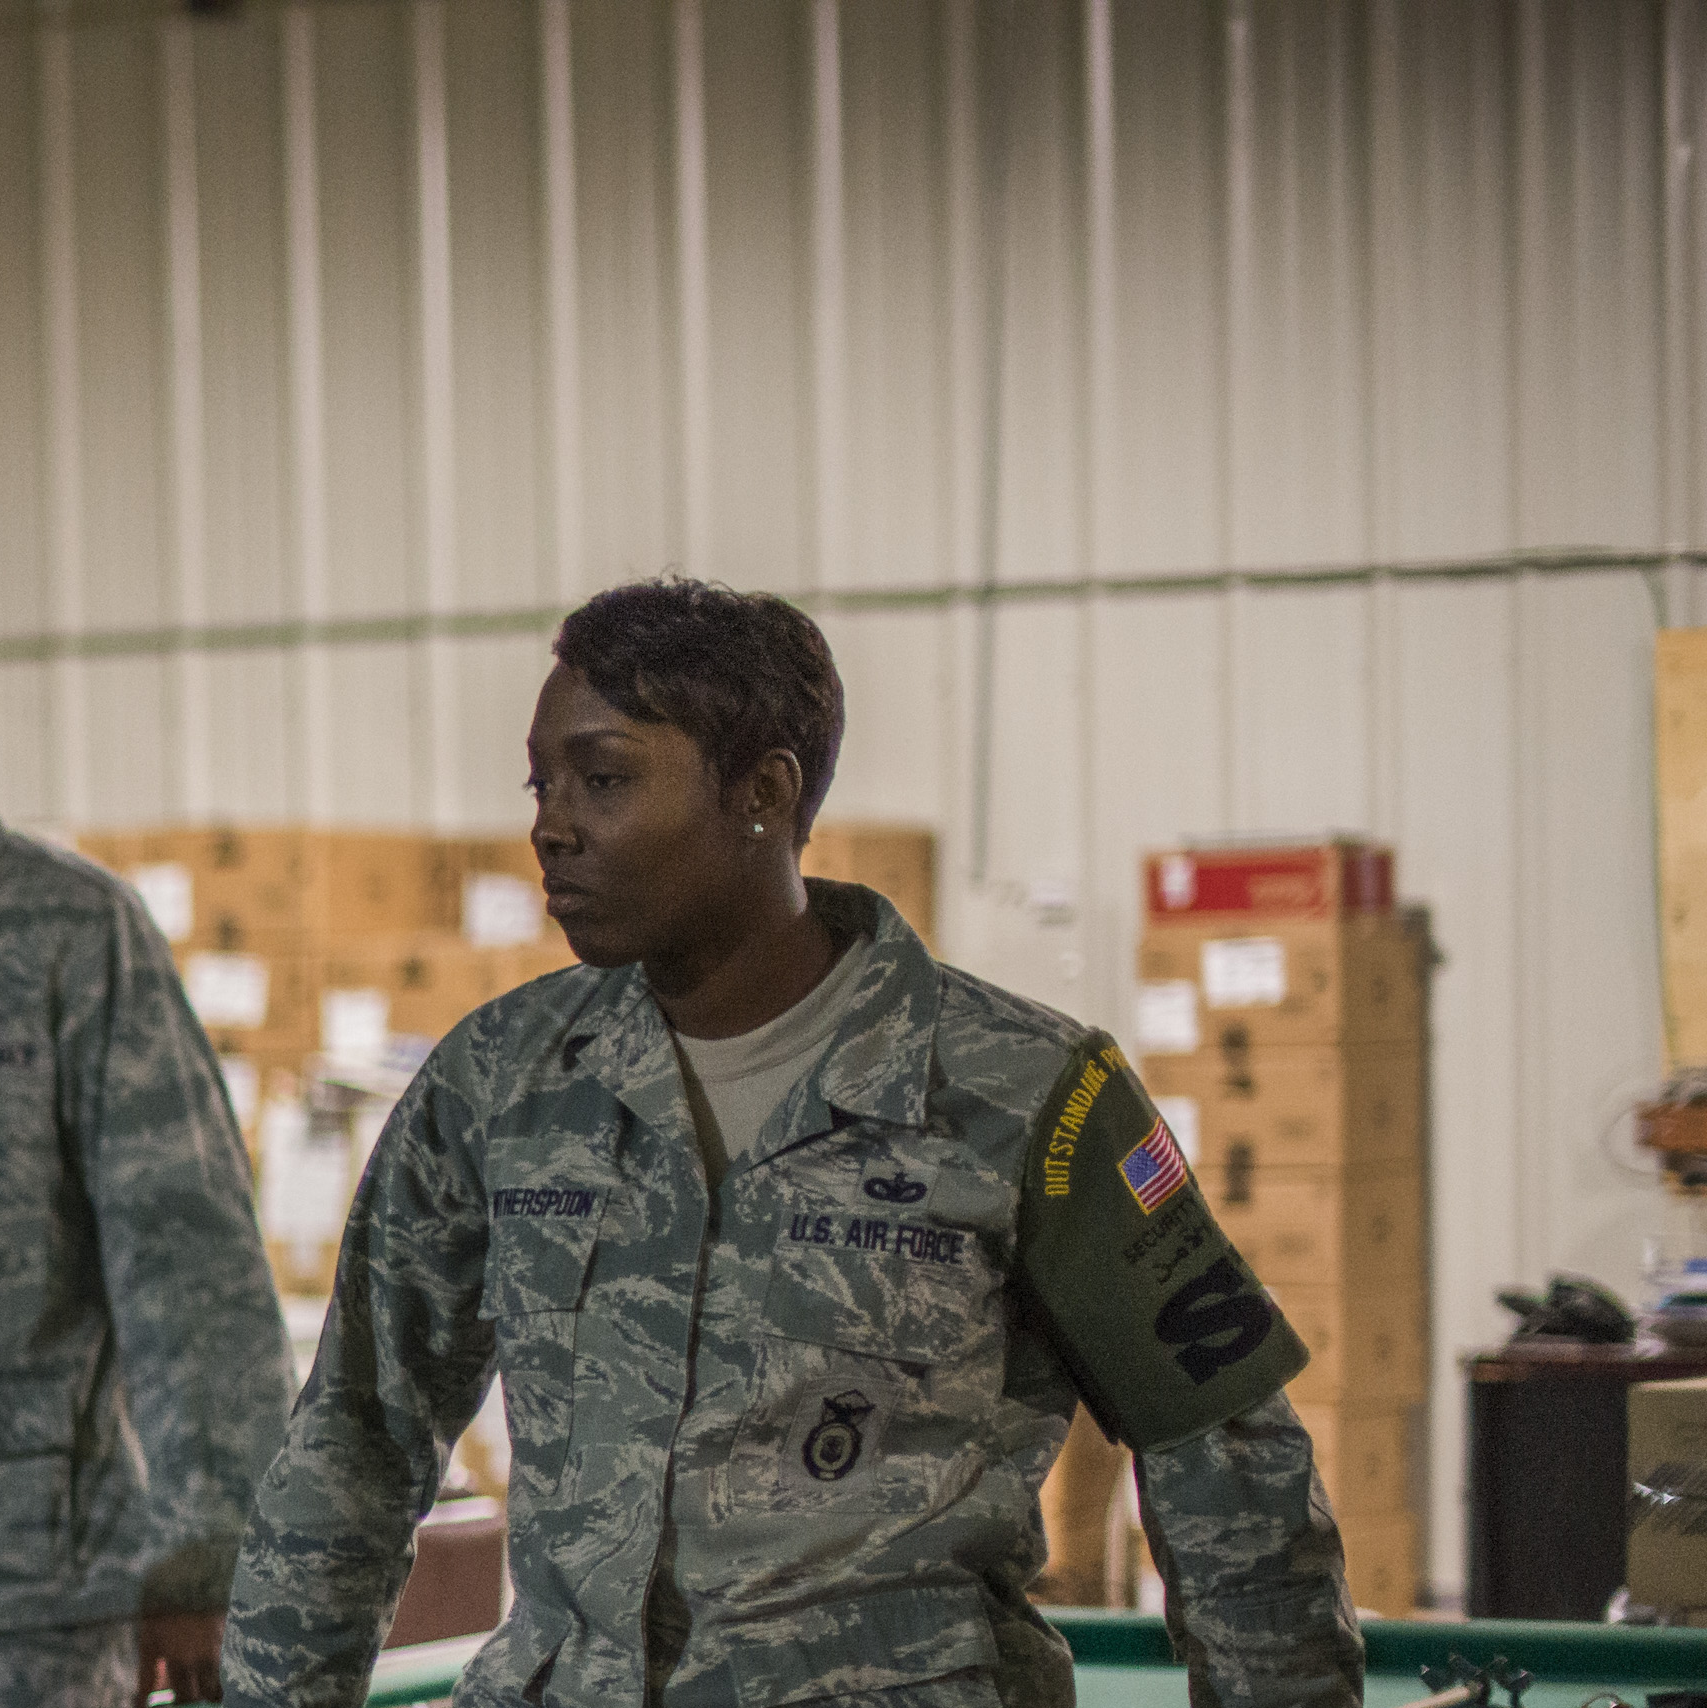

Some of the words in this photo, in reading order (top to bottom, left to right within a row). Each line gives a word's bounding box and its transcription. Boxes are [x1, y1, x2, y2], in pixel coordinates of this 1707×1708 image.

[1044, 1059, 1109, 1197] OUTSTANDING
[844, 1218, 889, 1251] AIR
[895, 1224, 966, 1265] FORCE
[1154, 1256, 1273, 1386] S
